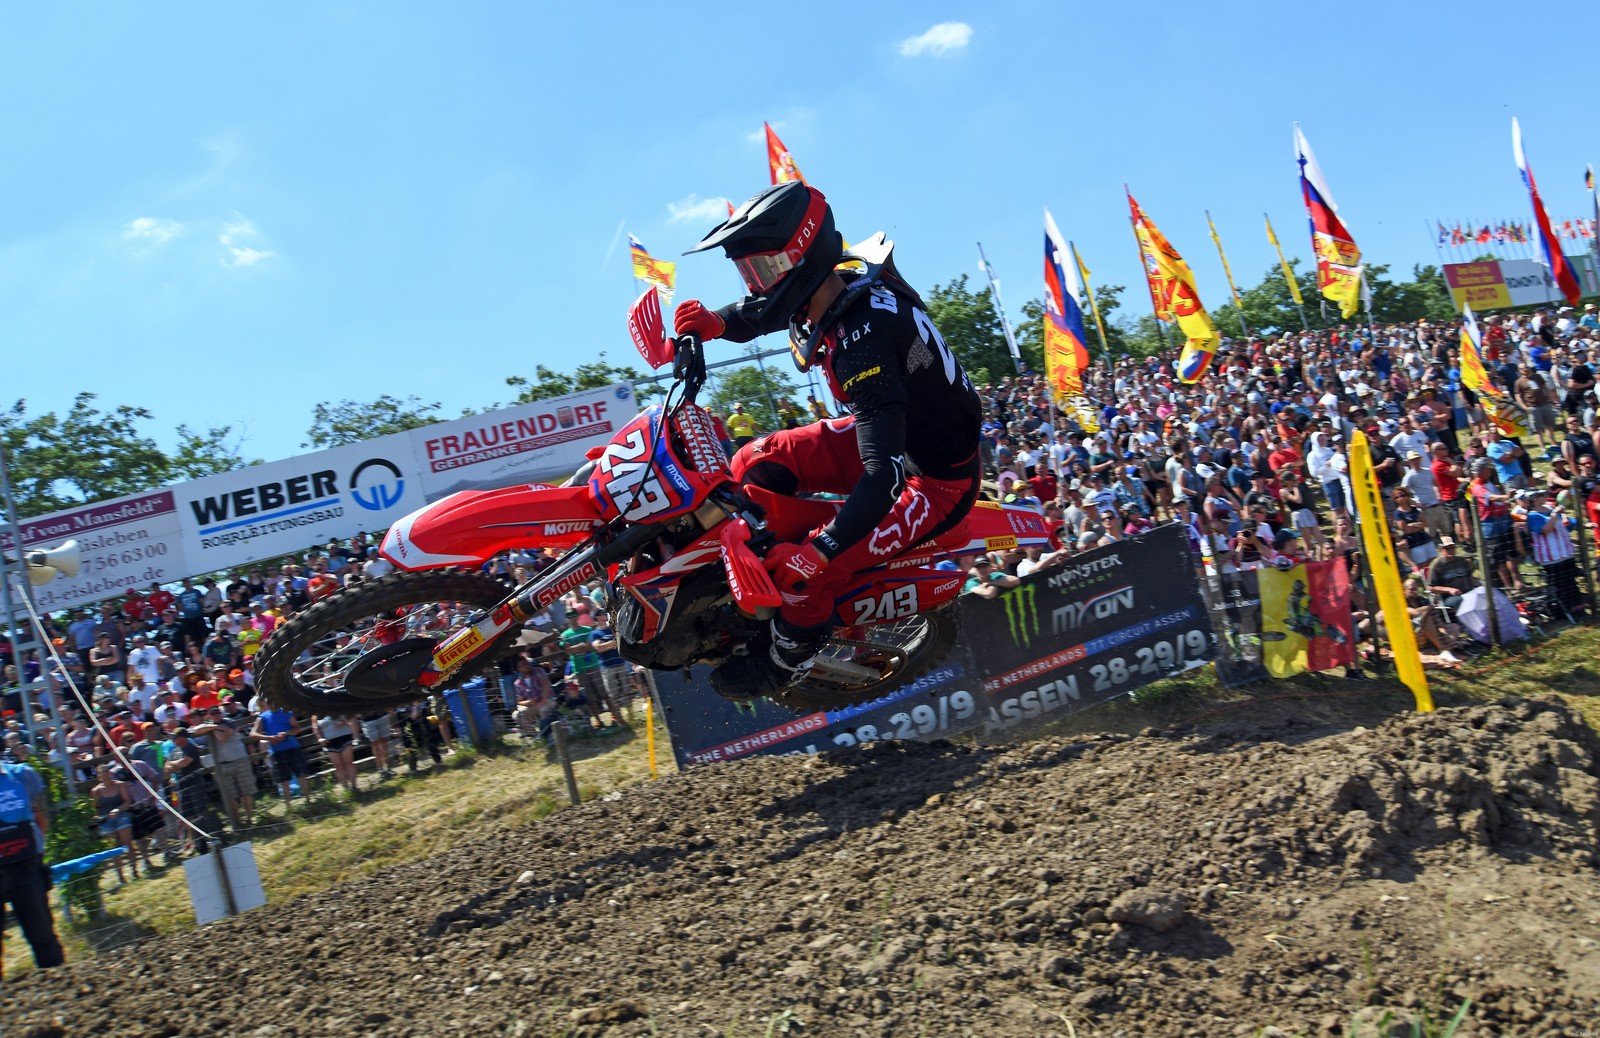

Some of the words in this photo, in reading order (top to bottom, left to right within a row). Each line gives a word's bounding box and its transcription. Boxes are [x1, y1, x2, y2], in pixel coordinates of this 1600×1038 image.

[797, 218, 816, 248] FOX
[842, 322, 872, 350] FOX
[685, 405, 721, 474] RENTHAL
[600, 429, 671, 522] 243
[665, 463, 690, 491] MXGP
[190, 469, 338, 525] WEBER
[200, 506, 344, 550] ROHRLEITUNGSBAU
[394, 527, 408, 560] HONDA
[544, 521, 590, 536] MOTUL
[820, 533, 838, 549] FOX
[987, 536, 1017, 549] PIRELLI
[537, 562, 595, 607] SHOWA
[934, 578, 960, 595] MXGP
[1048, 554, 1123, 588] MONSTER
[854, 583, 919, 625] 243
[438, 631, 479, 666] PIRELLI
[1002, 648, 1083, 686] NETHERLANDS
[1107, 622, 1152, 646] CIRCUIT
[1154, 609, 1192, 629] ASSEN
[983, 674, 1081, 737] ASSEN
[1089, 630, 1208, 693] 28-29/9
[694, 749, 722, 765] THE
[724, 716, 823, 755] NETHERLANDS
[911, 668, 955, 691] ASSEN
